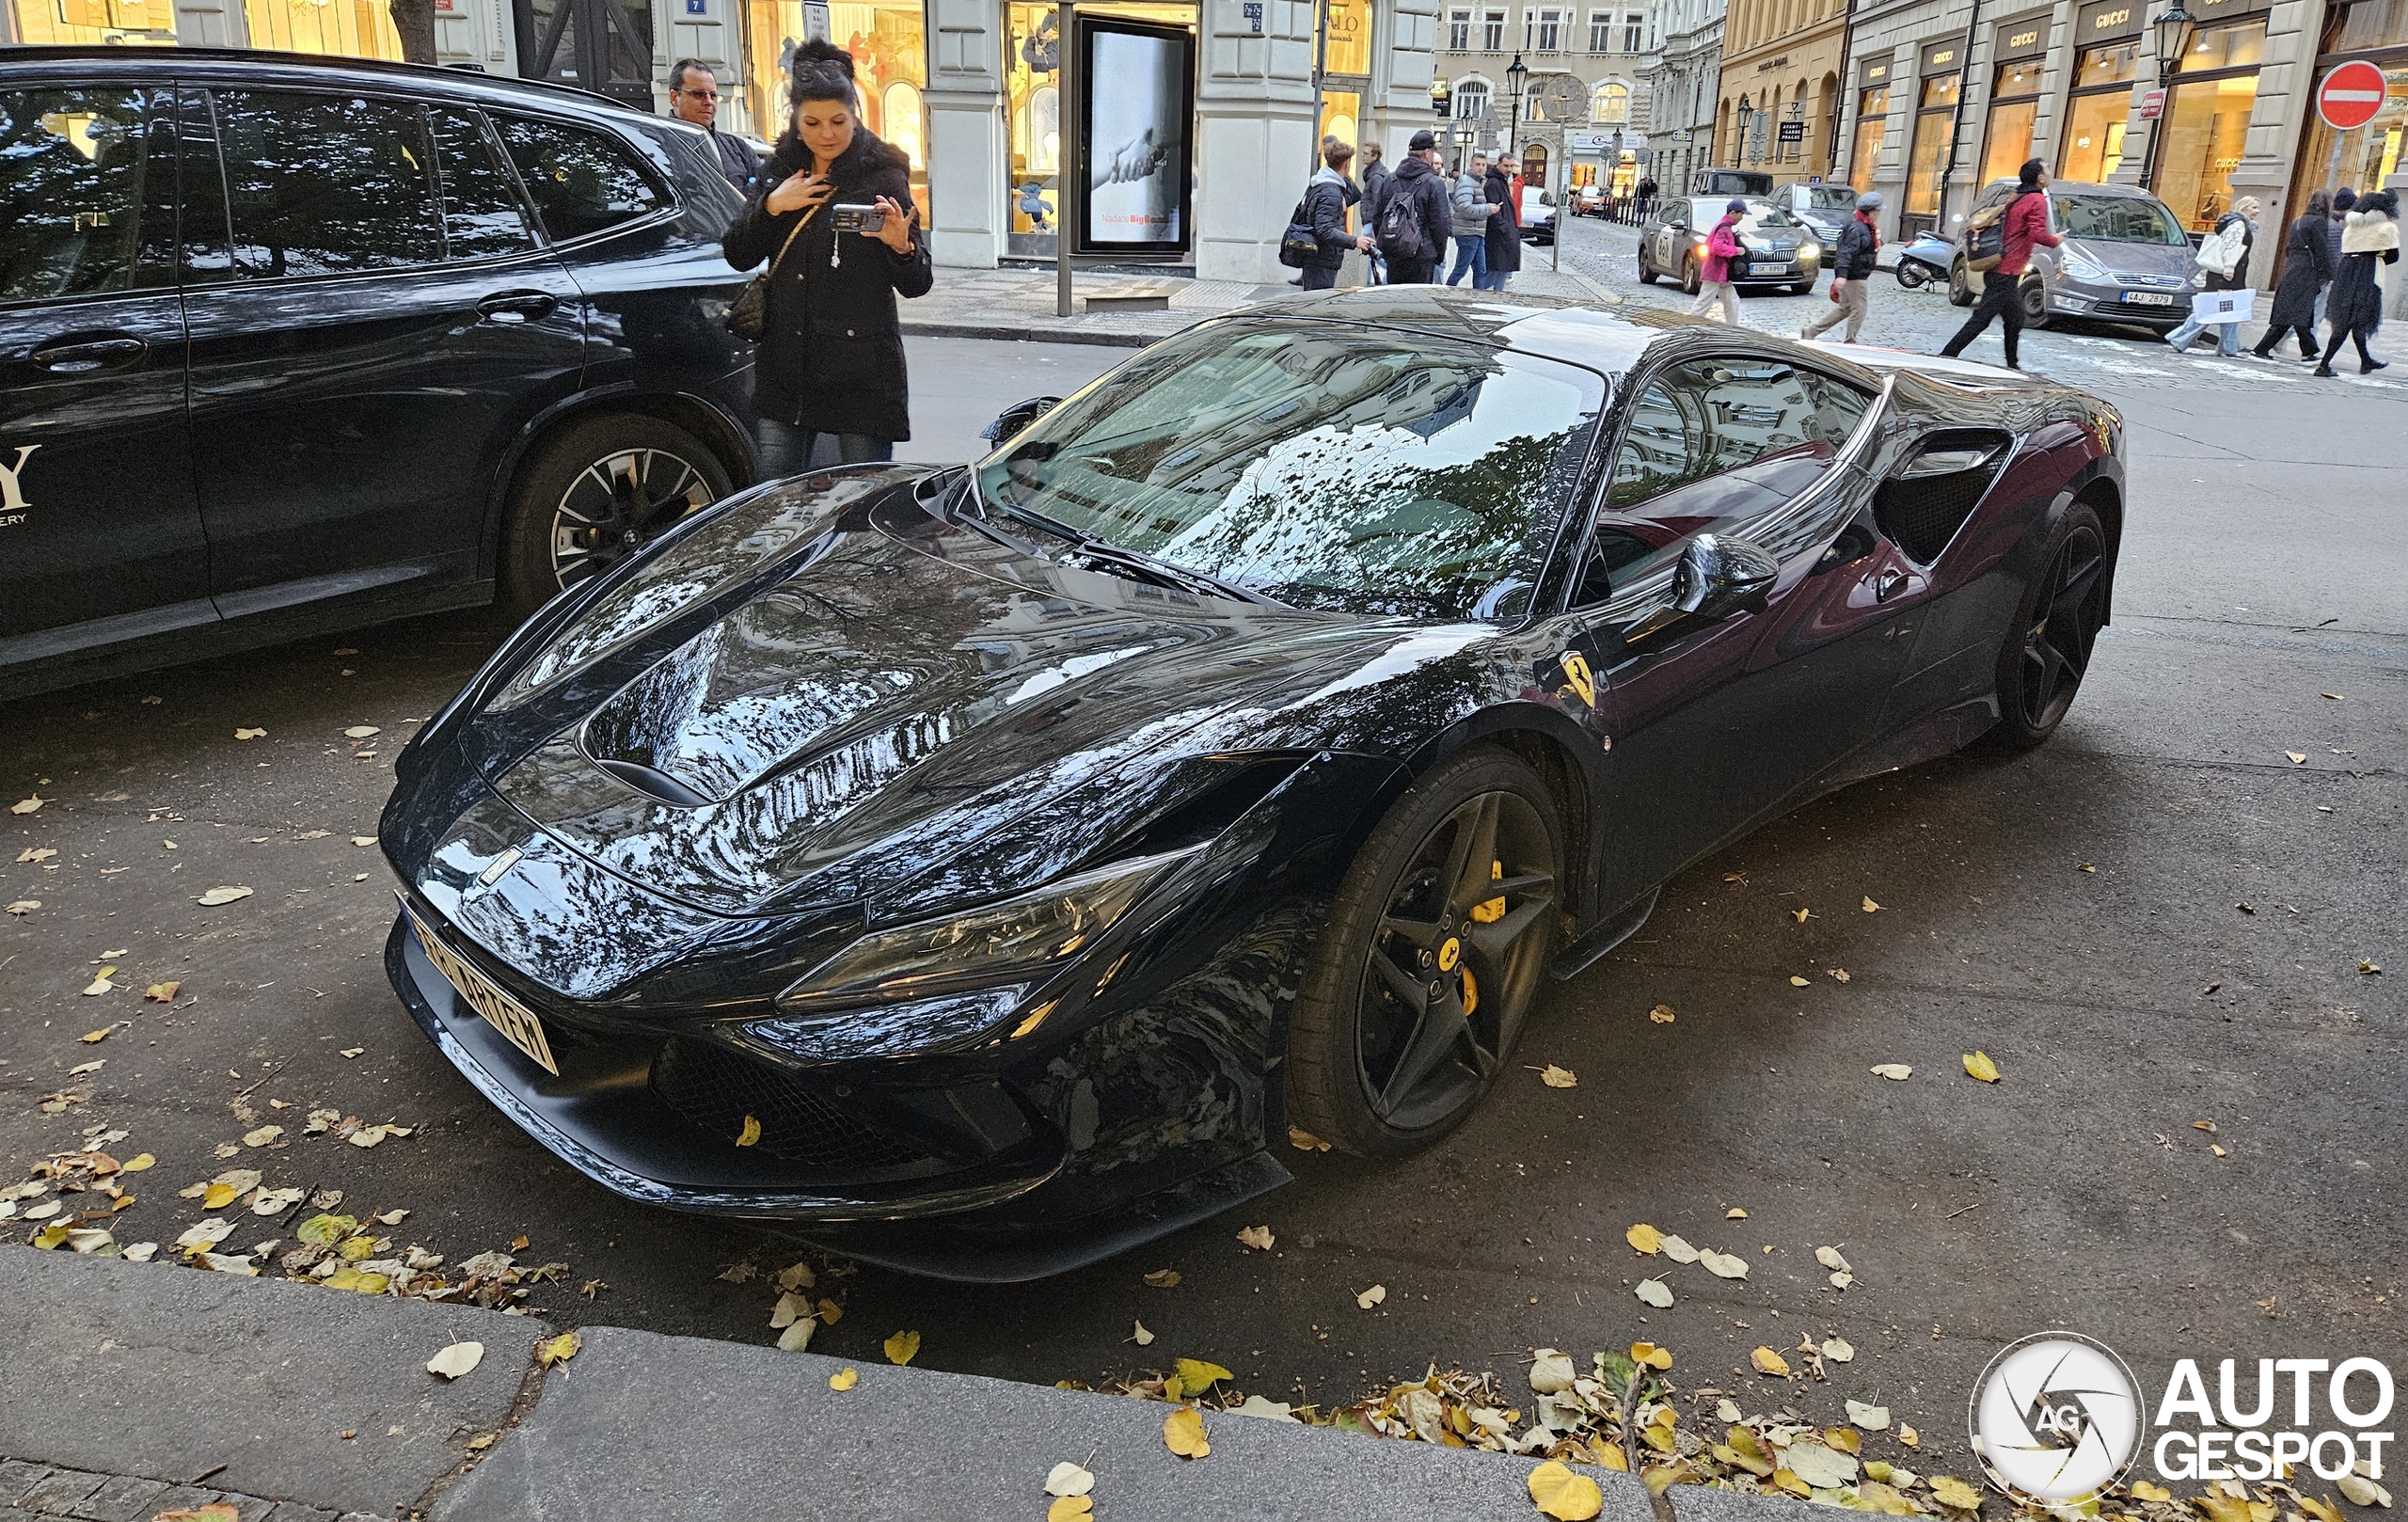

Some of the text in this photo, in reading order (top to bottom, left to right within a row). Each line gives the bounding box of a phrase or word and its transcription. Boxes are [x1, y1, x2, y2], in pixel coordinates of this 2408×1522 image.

[2096, 8, 2131, 29] GUCCI
[2010, 30, 2037, 48] GUCCI
[1933, 50, 1954, 65] GUCCI
[1869, 65, 1887, 78] GUCCI
[1101, 214, 1130, 223] Nadace
[2129, 293, 2170, 304] 4AJ 2879
[456, 962, 547, 1064] ARTEM
